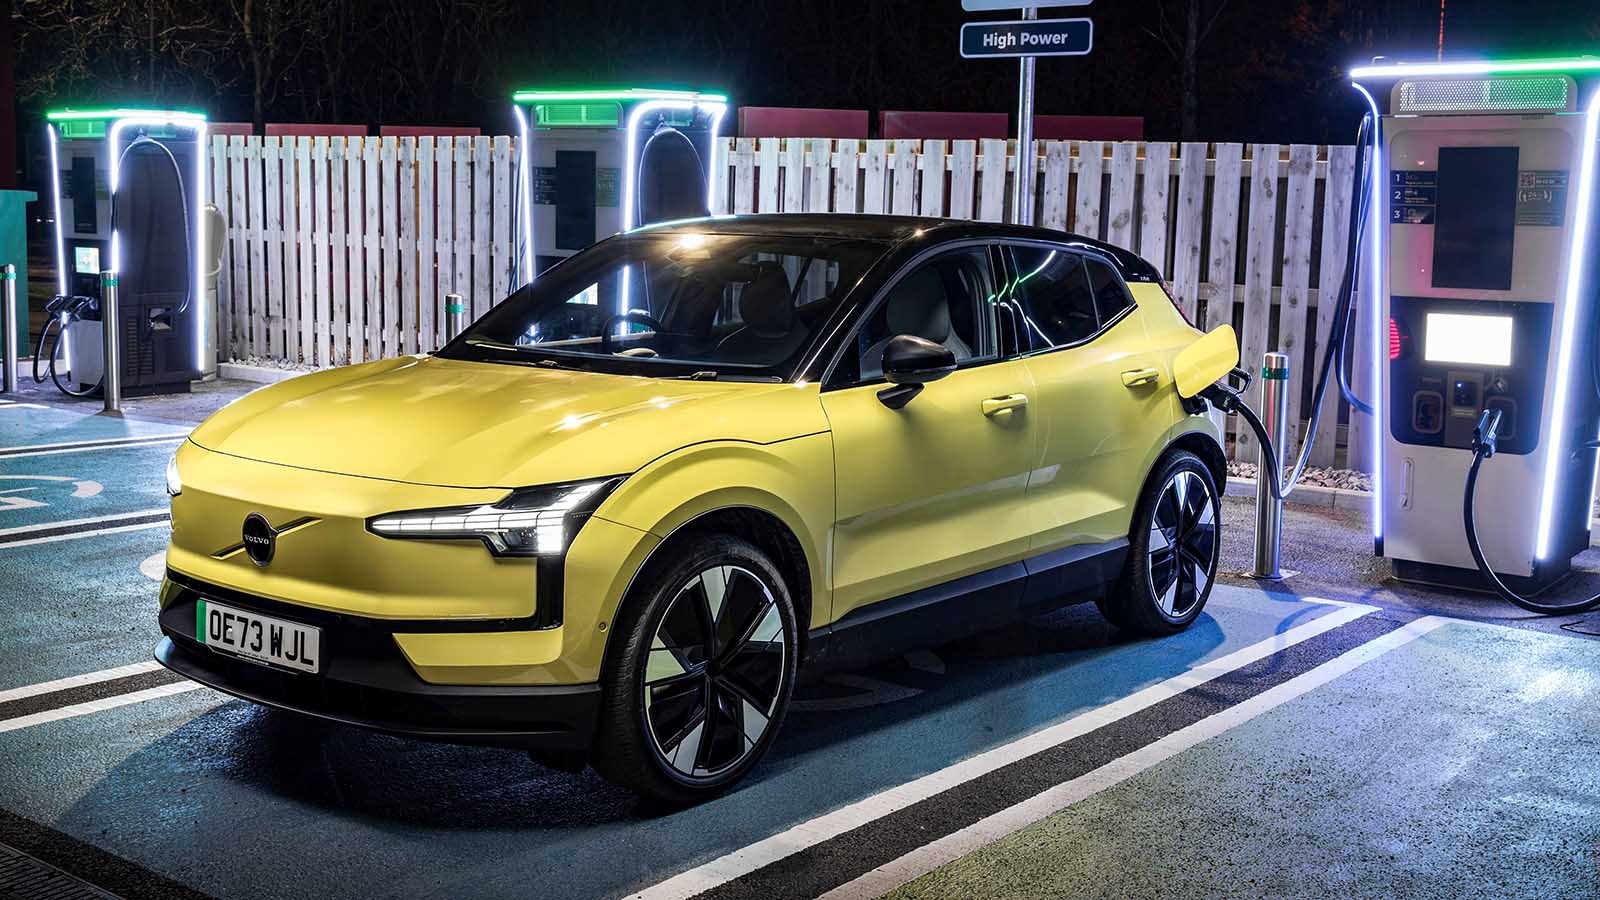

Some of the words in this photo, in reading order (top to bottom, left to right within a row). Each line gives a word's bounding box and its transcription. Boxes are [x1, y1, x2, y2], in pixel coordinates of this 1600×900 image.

[983, 32, 1016, 49] High
[1020, 32, 1068, 45] Power
[1394, 191, 1401, 200] 2
[1394, 210, 1401, 219] 3
[244, 534, 269, 545] VOLVO
[210, 609, 263, 652] OE73
[270, 624, 314, 666] WJL
